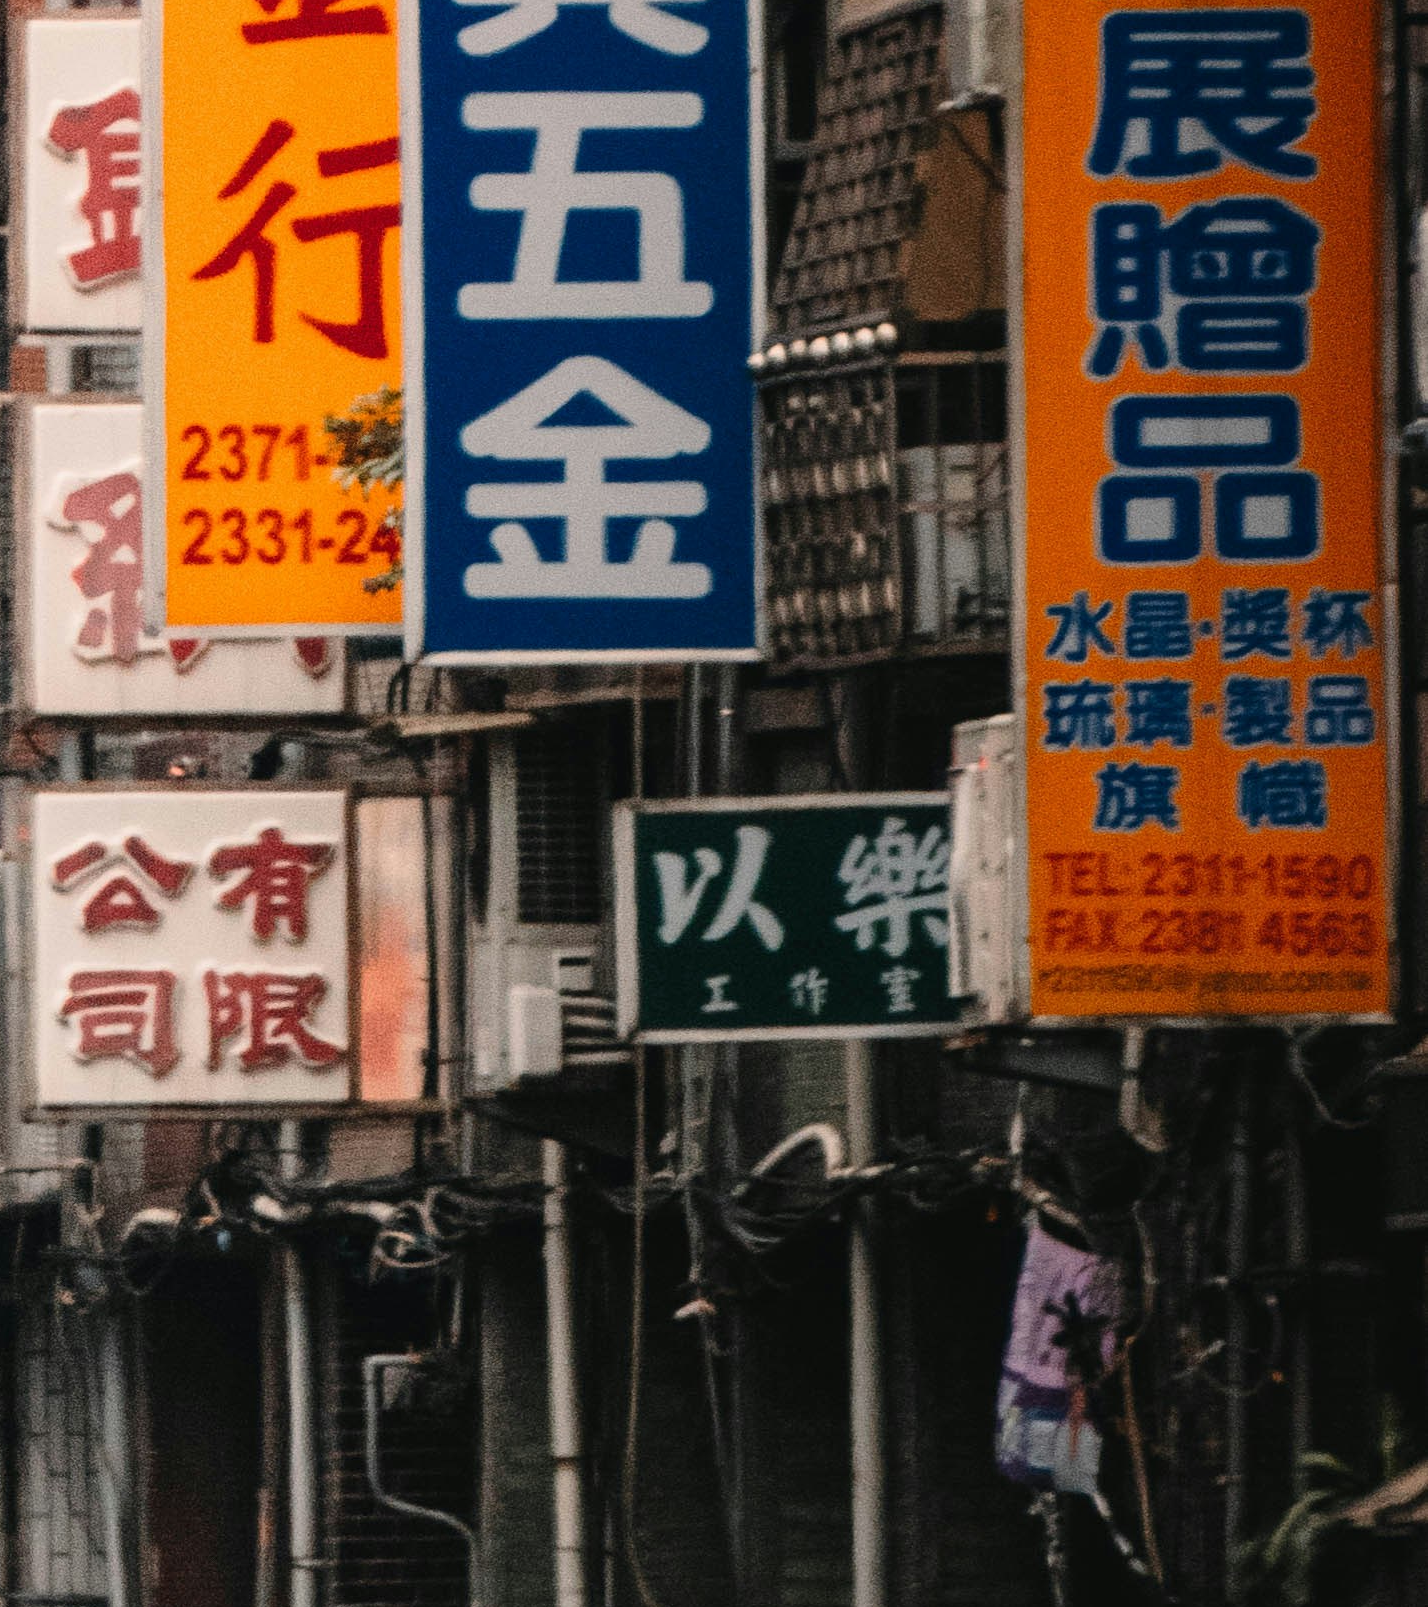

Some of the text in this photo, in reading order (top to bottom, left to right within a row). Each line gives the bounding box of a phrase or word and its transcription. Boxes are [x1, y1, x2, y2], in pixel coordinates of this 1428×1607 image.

[1095, 760, 1327, 830] 旗幟
[653, 820, 950, 953] 以樂
[702, 966, 920, 1014] 工作室
